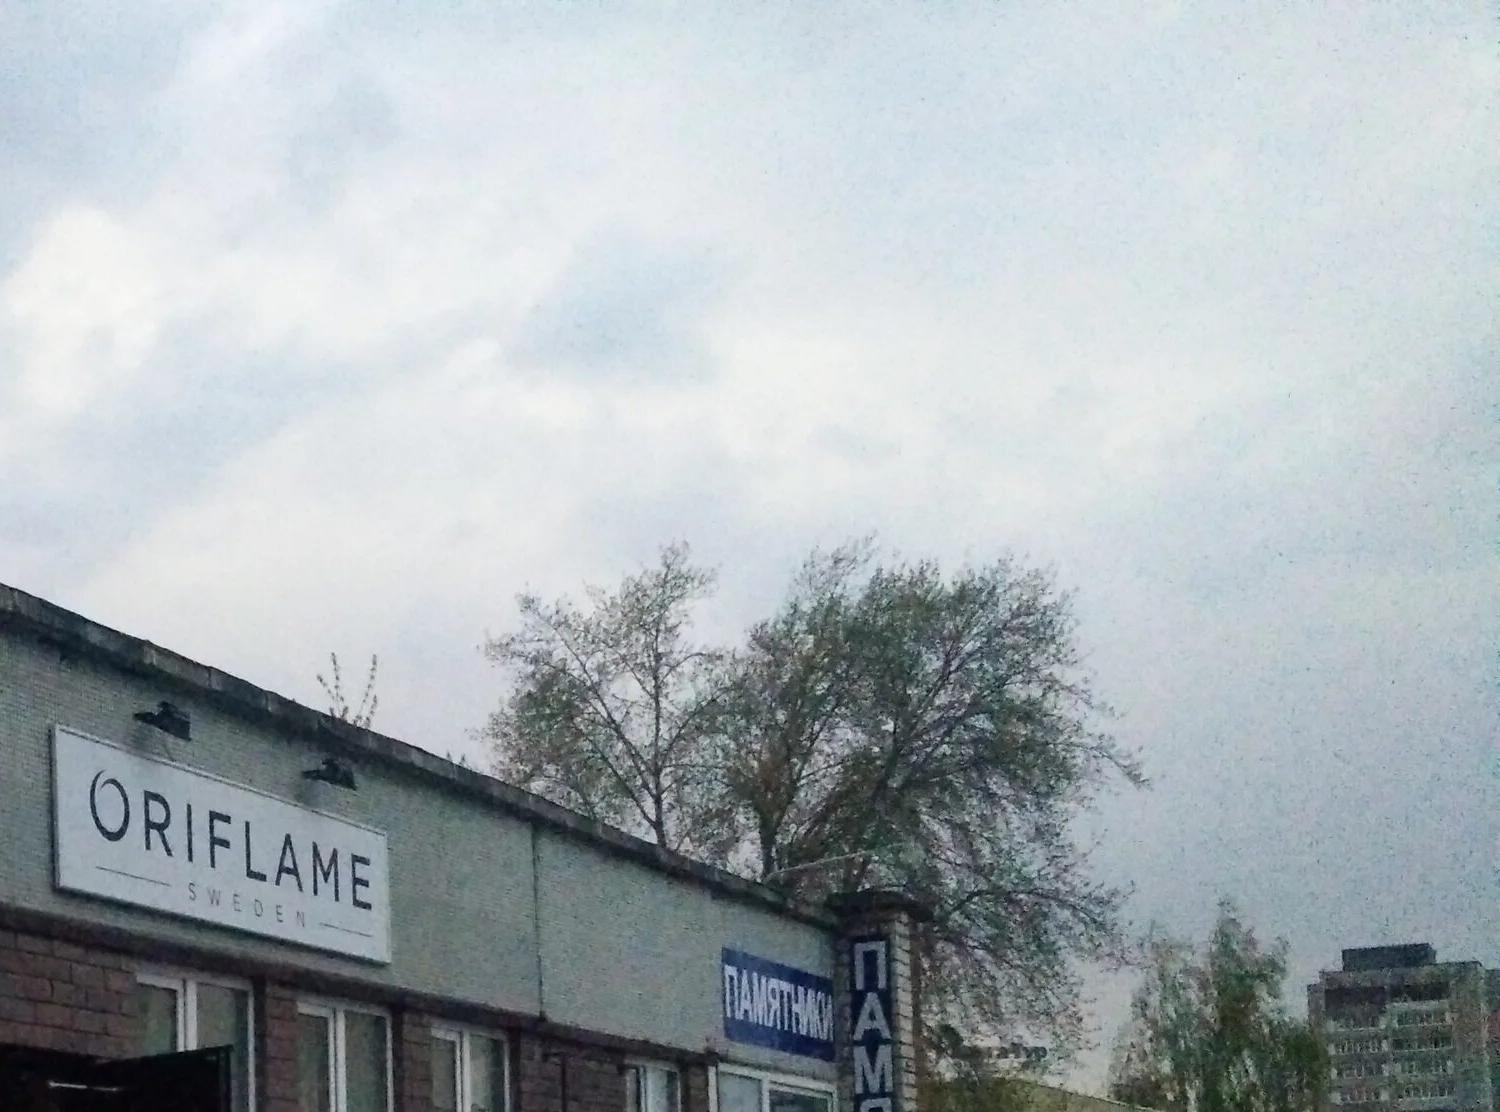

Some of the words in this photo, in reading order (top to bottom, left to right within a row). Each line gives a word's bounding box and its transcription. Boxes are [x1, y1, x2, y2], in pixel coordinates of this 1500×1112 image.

[90, 769, 372, 910] ORIFLAME
[188, 882, 305, 928] SWEDEN
[724, 964, 833, 1042] ПАМЯТНИКИ
